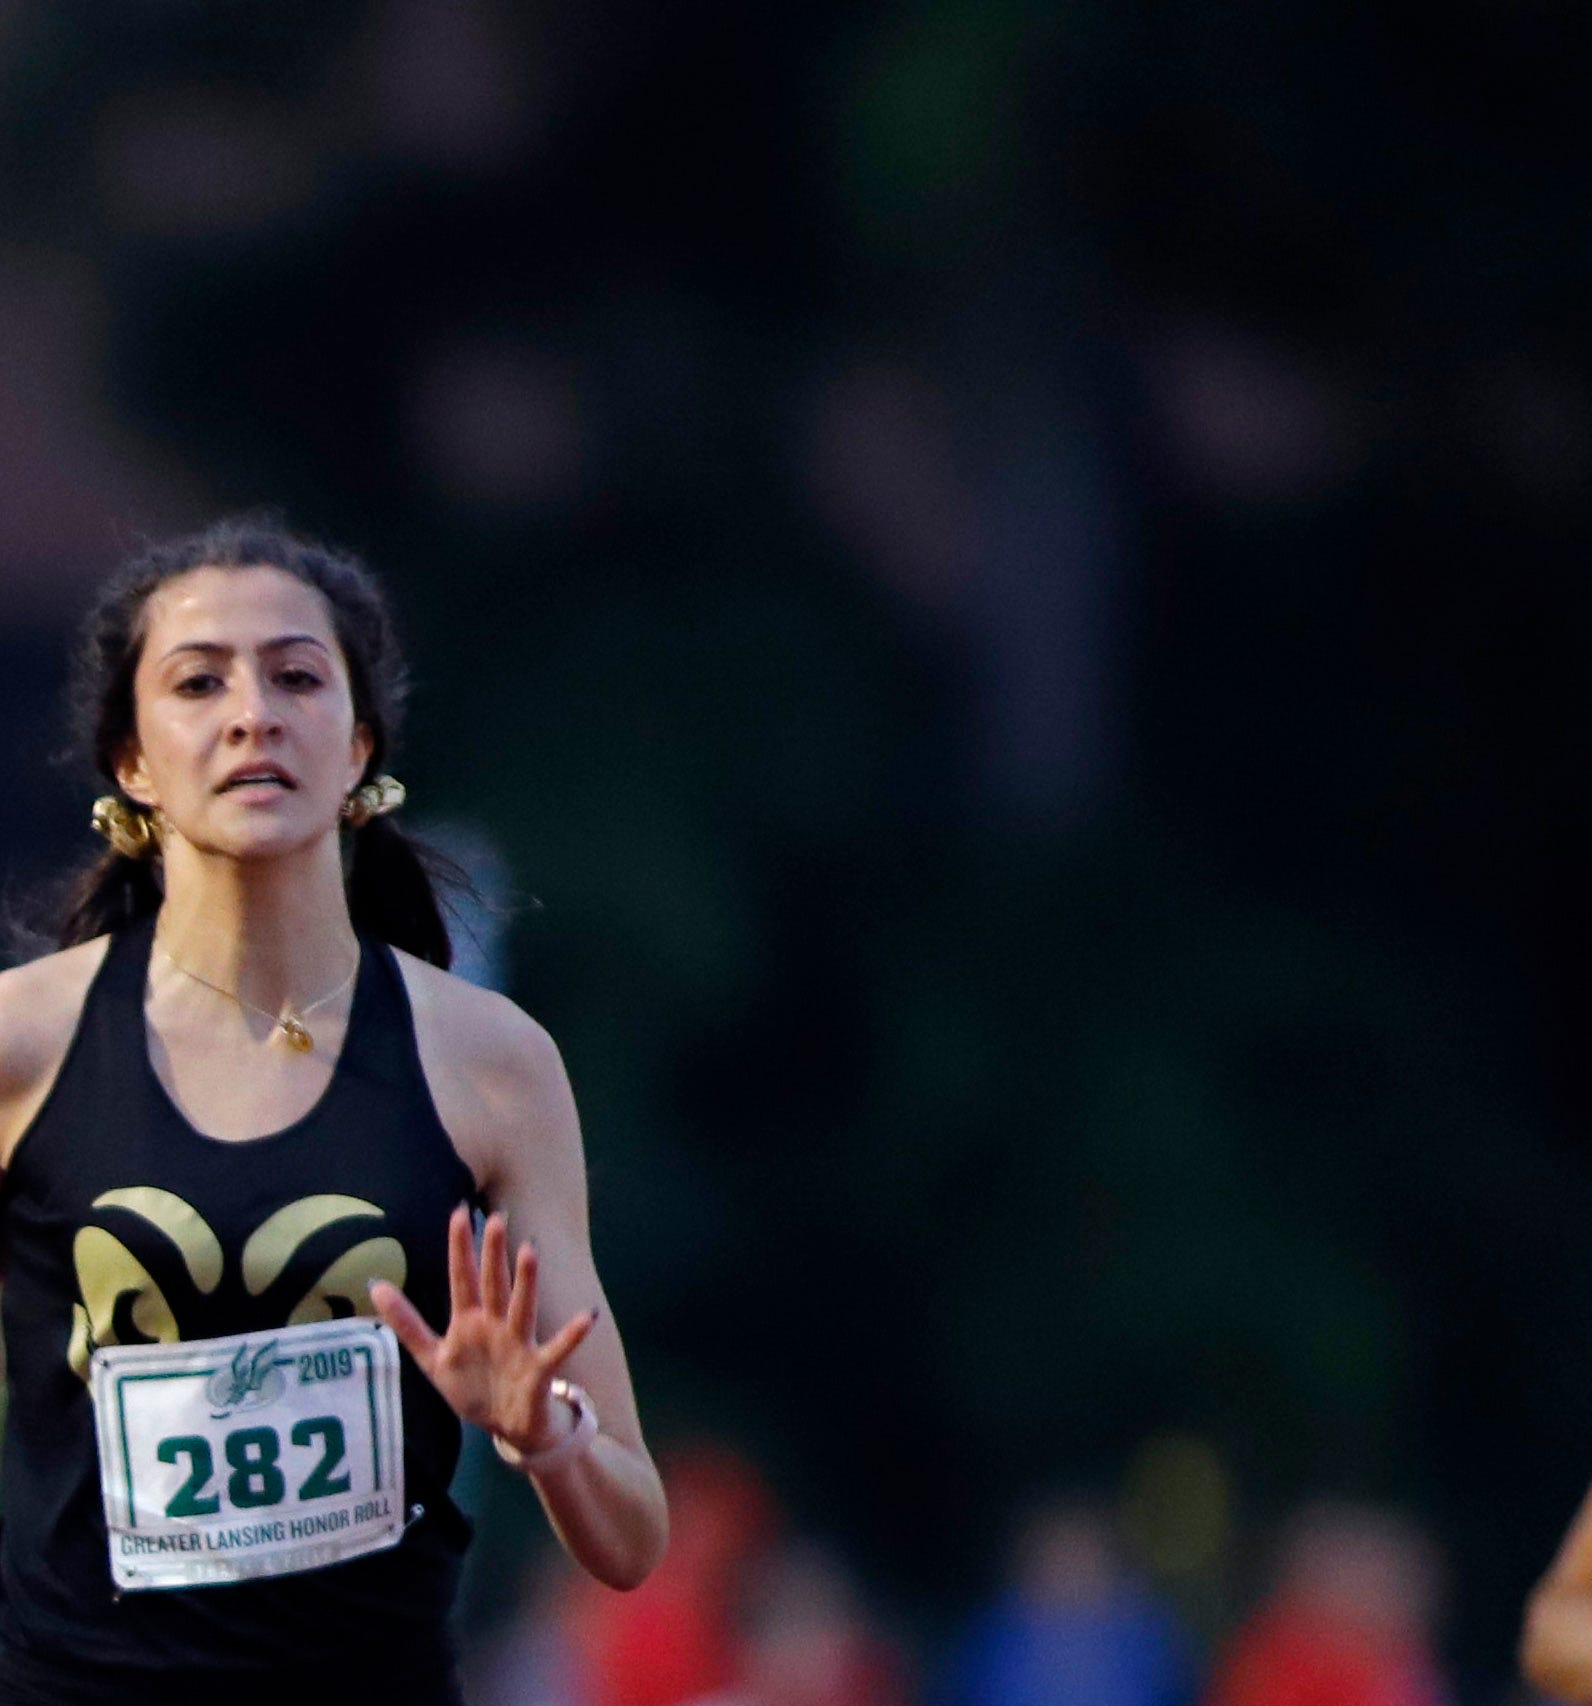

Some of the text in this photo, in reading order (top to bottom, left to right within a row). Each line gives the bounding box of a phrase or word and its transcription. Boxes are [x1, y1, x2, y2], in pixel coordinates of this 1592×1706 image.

[298, 1348, 353, 1384] 2019
[156, 1415, 352, 1518] 282
[120, 1498, 392, 1557] GREATER LANSING HONOR ROLL
